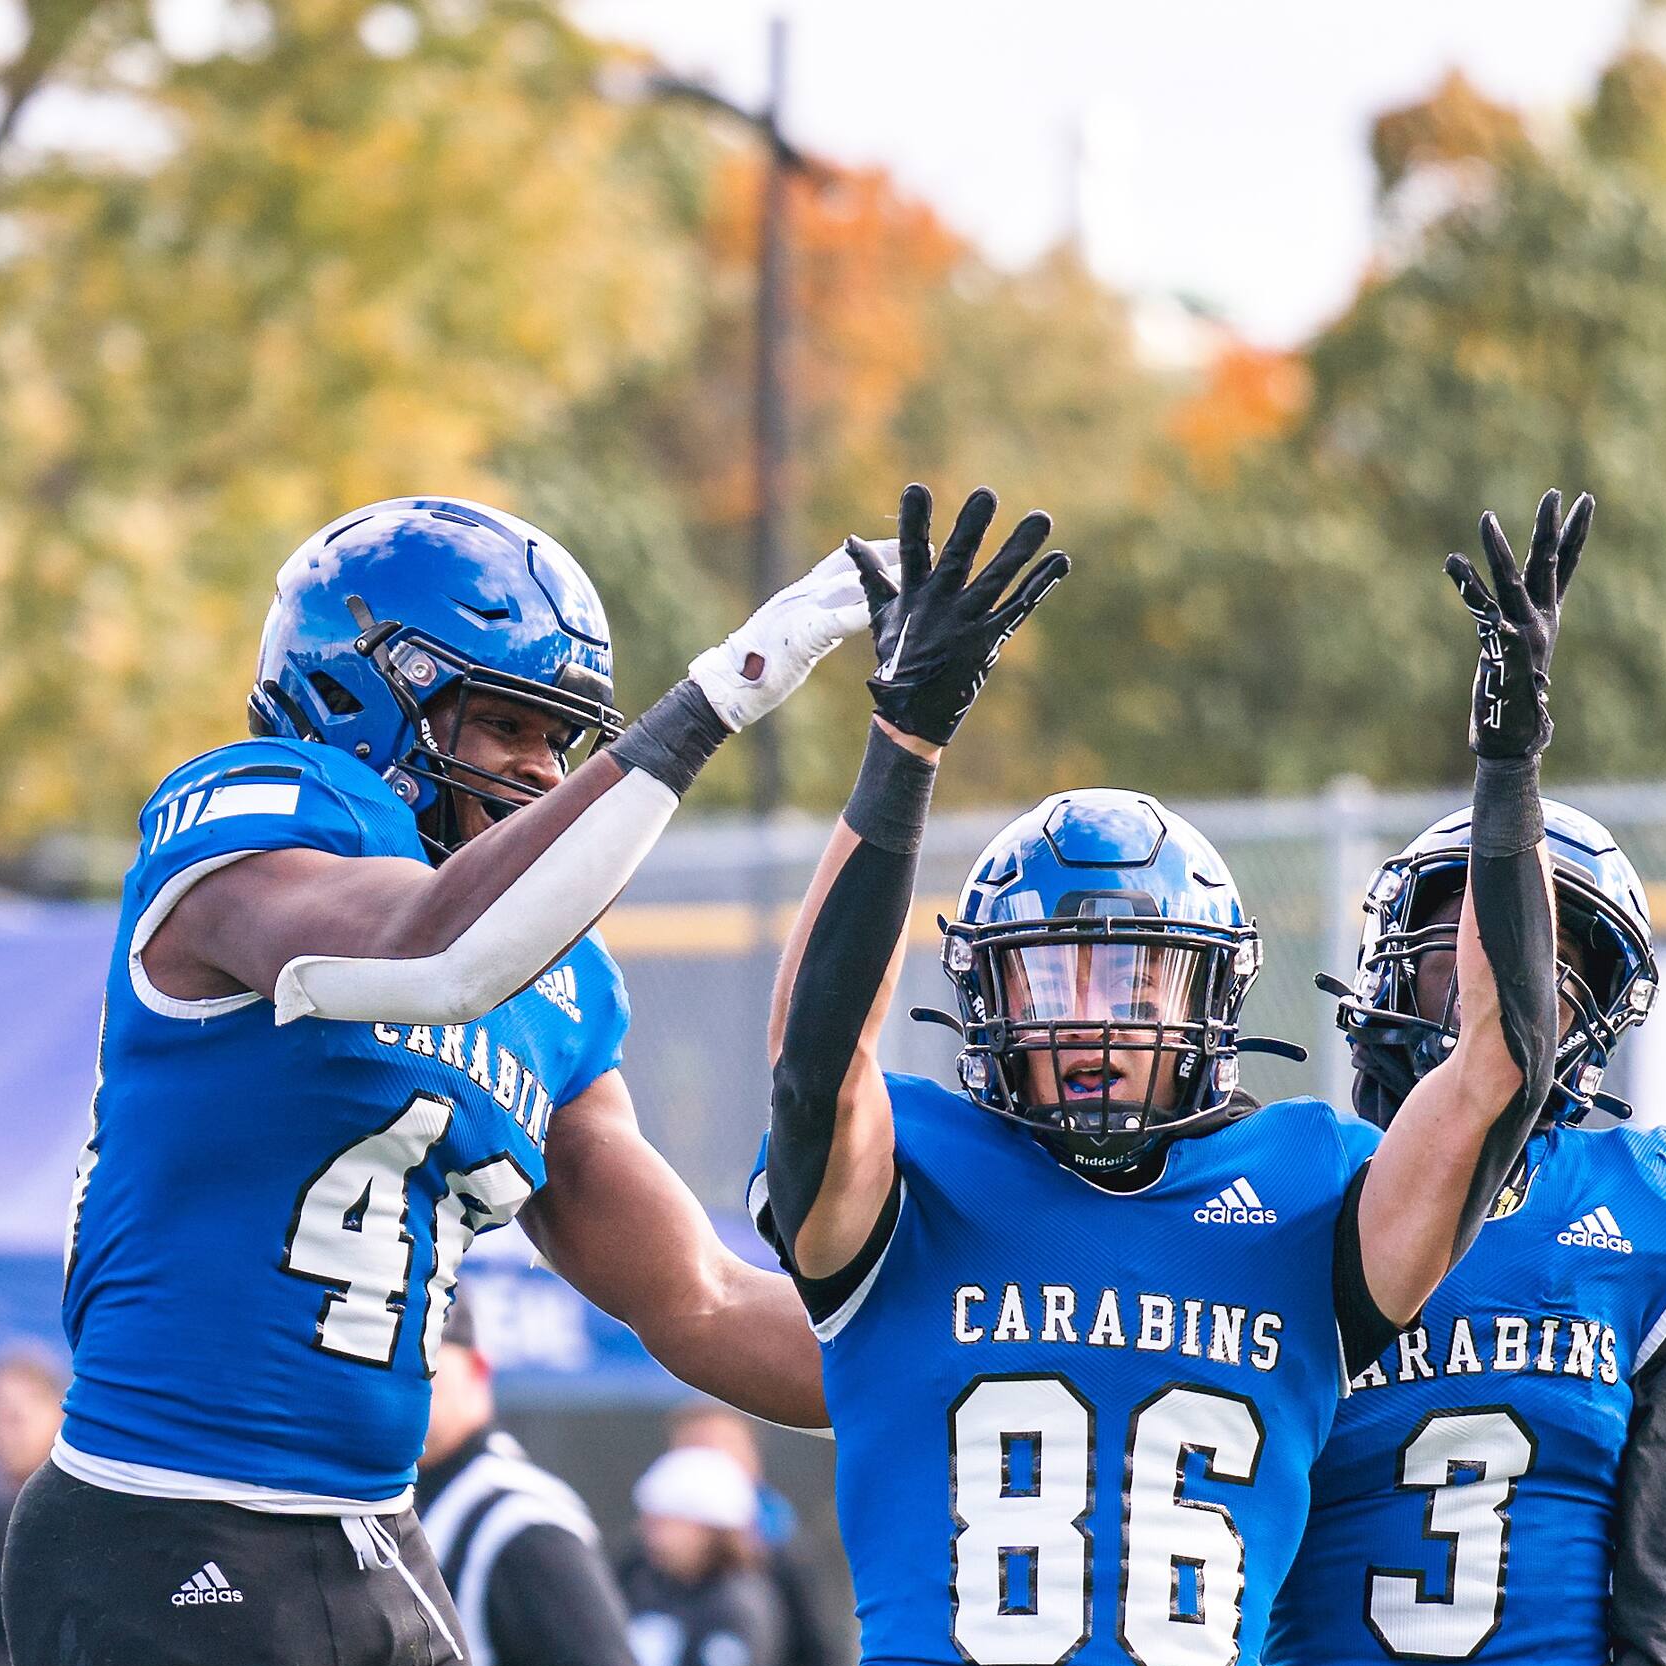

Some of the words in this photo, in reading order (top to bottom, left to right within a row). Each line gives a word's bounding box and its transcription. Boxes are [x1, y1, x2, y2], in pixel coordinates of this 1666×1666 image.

[1193, 1205, 1278, 1225] adidas
[1556, 1229, 1633, 1255] adidas
[950, 1281, 1284, 1373] CARABINS
[1349, 1315, 1621, 1389] ARABINS
[1362, 1402, 1541, 1661] 3
[171, 1586, 244, 1608] adidas
